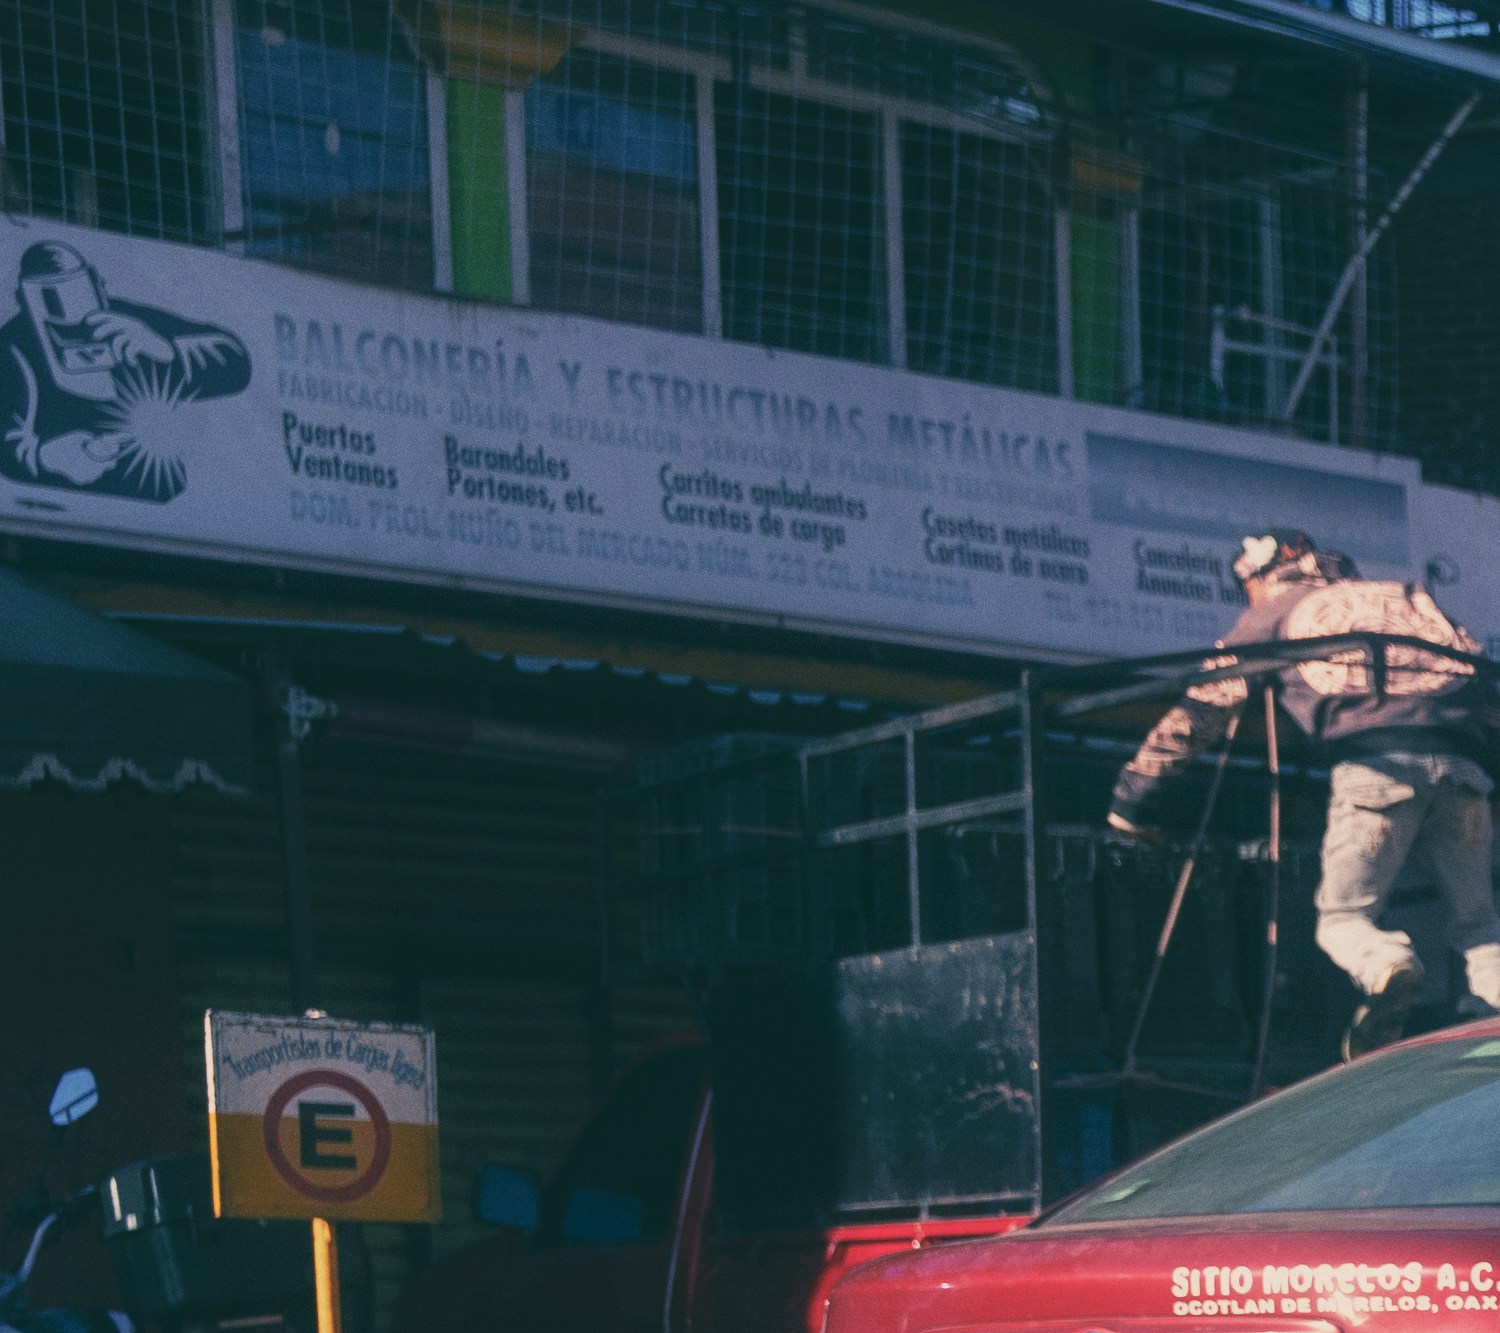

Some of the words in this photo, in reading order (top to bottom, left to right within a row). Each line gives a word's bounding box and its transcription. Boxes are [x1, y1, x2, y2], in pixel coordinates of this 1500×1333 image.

[273, 311, 536, 398] BALCONERÍA
[558, 357, 583, 402] Y
[606, 366, 868, 443] ESTRUCTURAS
[886, 410, 1074, 480] METÁLICAS
[281, 409, 377, 457] Puertas
[284, 443, 398, 490] Ventanas
[443, 435, 571, 482] Barandales
[446, 465, 556, 514] Portones,
[563, 485, 605, 516] etc.
[658, 462, 744, 503] Carritos
[749, 475, 869, 521] ambulantes
[661, 496, 751, 535] Carretas
[758, 502, 784, 538] de
[789, 518, 847, 553] carga
[921, 504, 998, 544] Casetas
[924, 536, 1004, 574] Cortinas
[1008, 545, 1033, 579] de
[1037, 557, 1090, 586] acero
[1135, 565, 1212, 603] Anuncios
[222, 1031, 321, 1082] Transportistas
[325, 1031, 343, 1059] de
[298, 1099, 357, 1171] E
[1170, 1264, 1253, 1298] SITIO
[1262, 1261, 1423, 1295] MORELOS
[1172, 1297, 1276, 1316] OCOTLAN
[1281, 1296, 1312, 1314] DE
